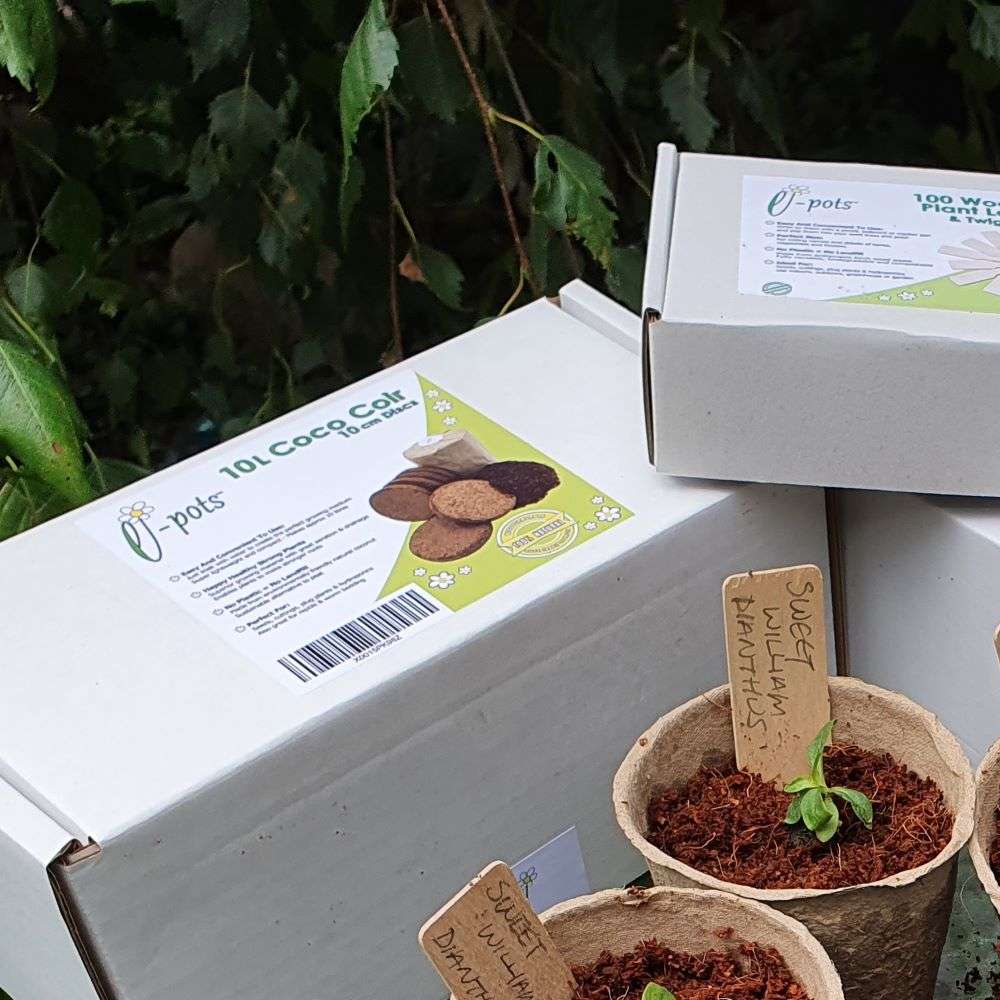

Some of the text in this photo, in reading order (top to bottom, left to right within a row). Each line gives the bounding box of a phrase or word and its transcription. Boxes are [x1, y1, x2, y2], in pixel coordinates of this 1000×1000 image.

[913, 193, 954, 205] 100
[921, 203, 979, 215] Plant
[949, 215, 962, 223] &
[219, 389, 406, 479] 10L Coco Coir
